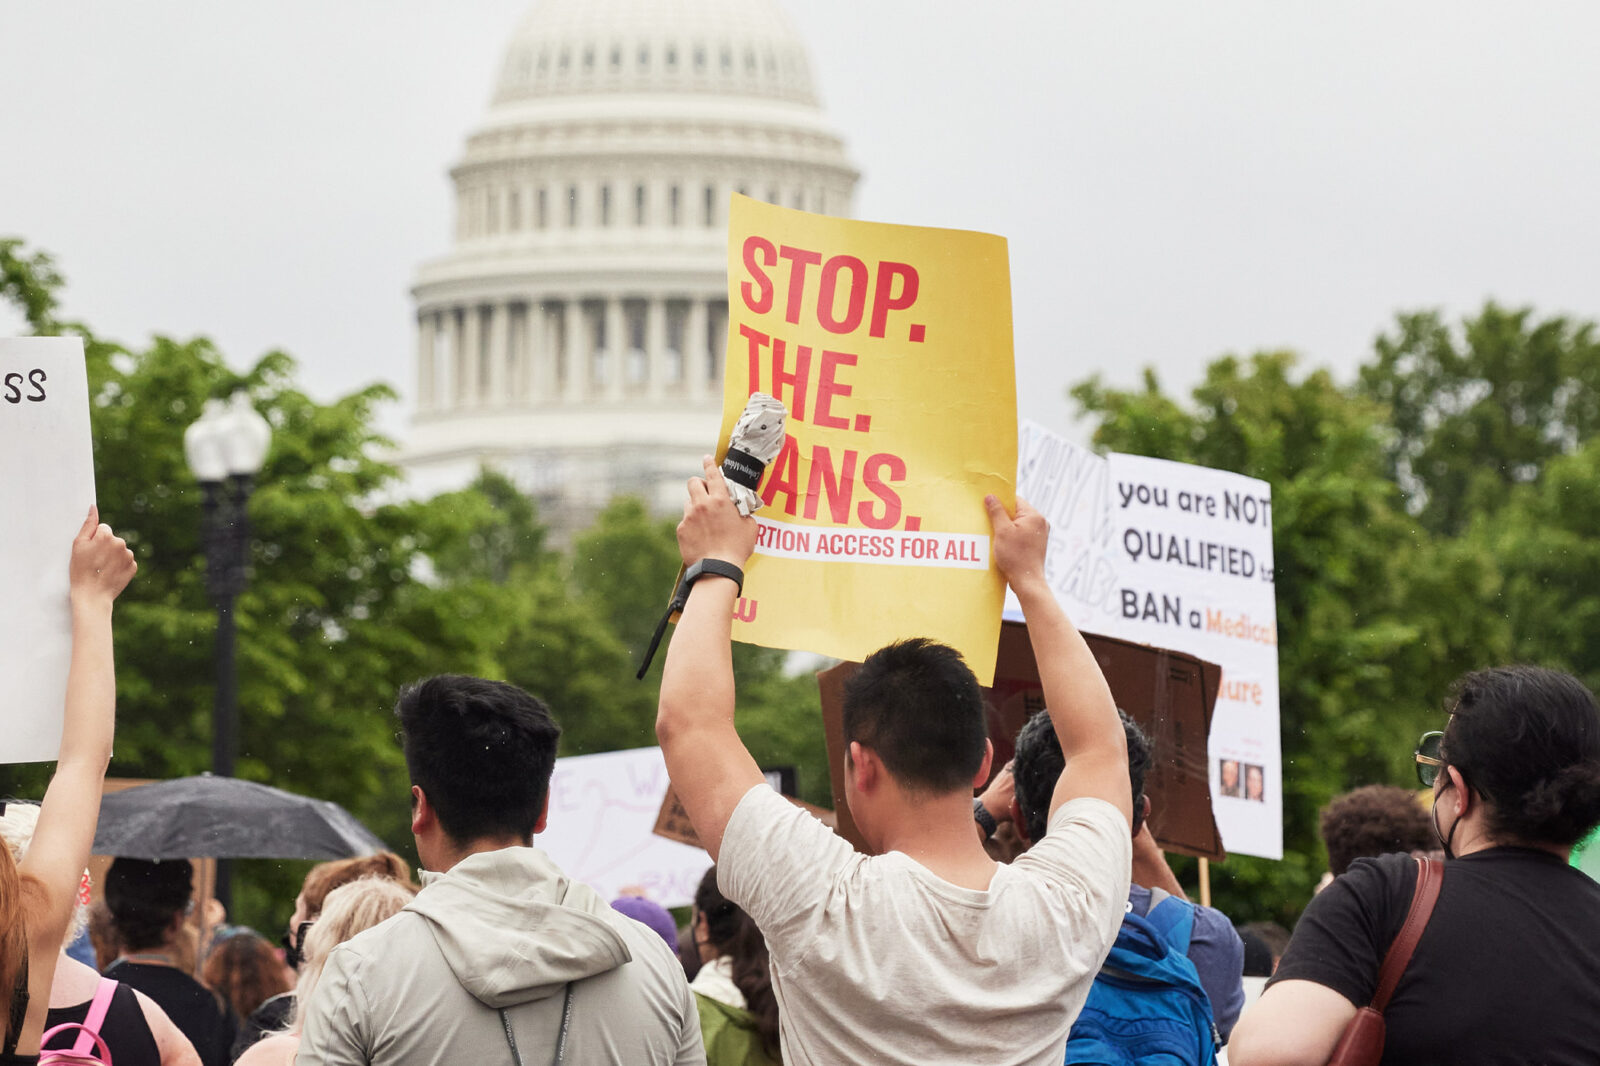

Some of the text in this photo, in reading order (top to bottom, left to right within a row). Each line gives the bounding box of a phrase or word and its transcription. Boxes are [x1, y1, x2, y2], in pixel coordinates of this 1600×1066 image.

[740, 235, 926, 343] STOP.
[739, 322, 872, 433] THE.
[756, 433, 922, 532] ANS.
[1118, 482, 1271, 527] you are NOT
[756, 523, 981, 562] RTION ACCESS FOR ALL
[1123, 528, 1256, 578] QUALIFIED
[1120, 589, 1181, 626] BAN
[1189, 610, 1201, 630] a
[1219, 676, 1262, 706] ure
